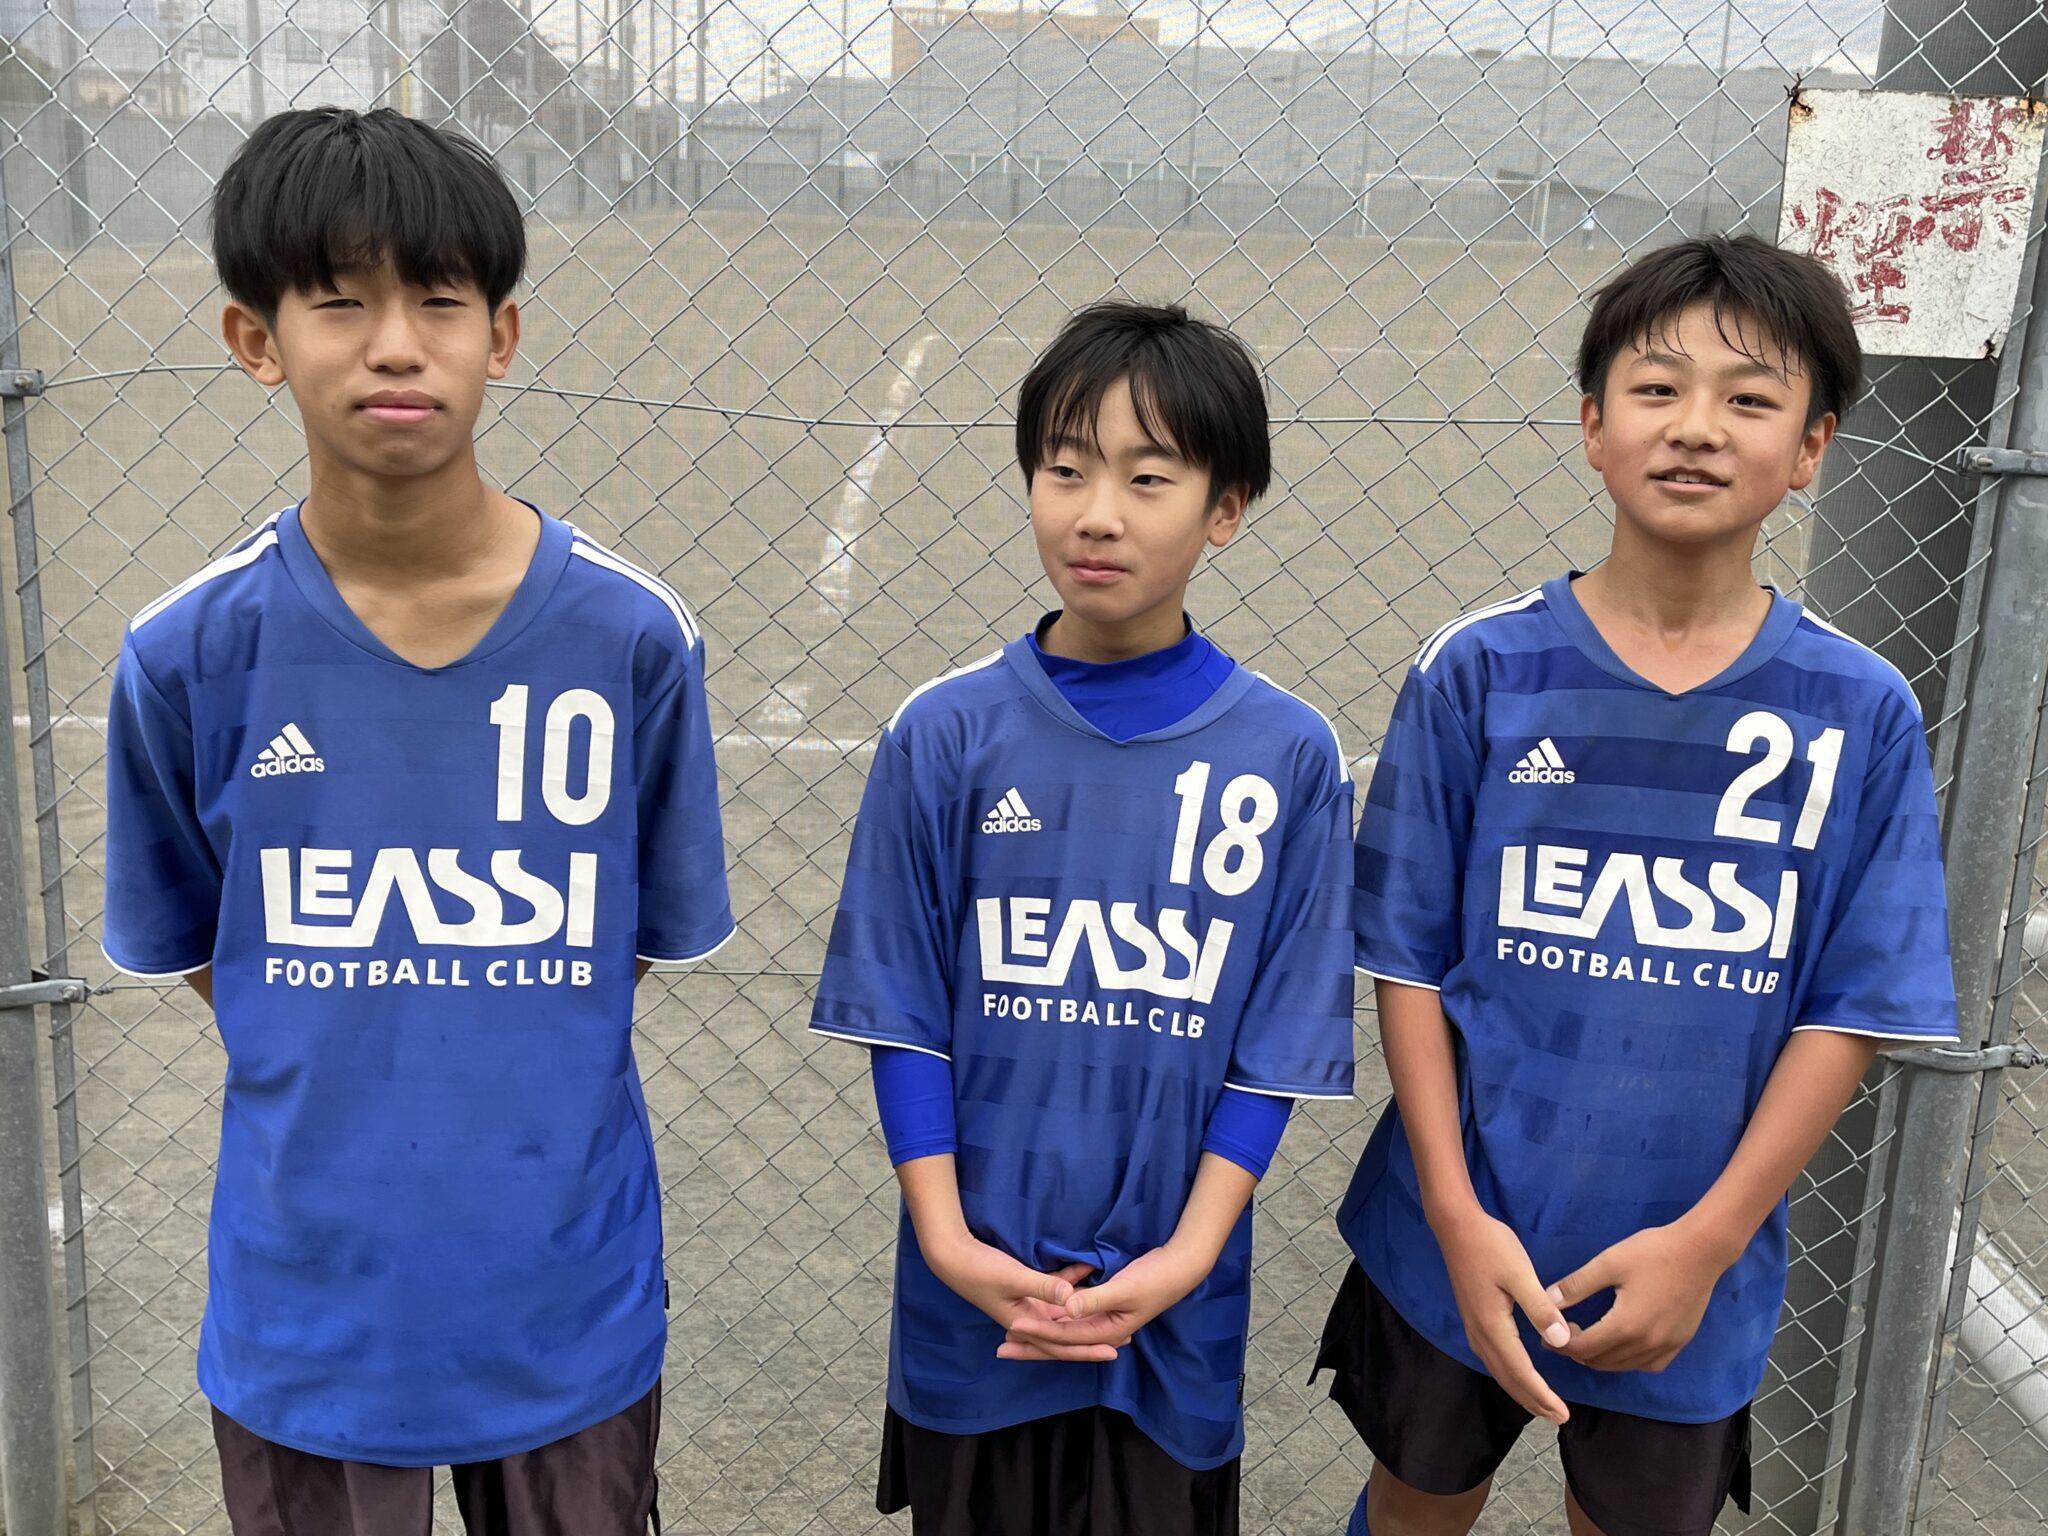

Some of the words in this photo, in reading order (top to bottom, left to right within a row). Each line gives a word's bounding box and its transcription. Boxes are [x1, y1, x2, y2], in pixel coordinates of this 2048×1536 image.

[250, 753, 326, 779] adidas
[489, 683, 615, 826] 10
[1508, 766, 1576, 784] adidas
[1713, 710, 1845, 851] 21
[981, 816, 1042, 834] adidas
[1169, 760, 1279, 896] 18
[260, 847, 598, 948] LEASSI
[1497, 844, 1798, 960] LEASSI
[265, 957, 470, 989] FOOTBALL
[485, 960, 594, 987] CLUB
[976, 896, 1234, 1005] LEASSI
[1497, 938, 1681, 987] FOOTBALL
[1692, 962, 1780, 995] CLUB
[983, 993, 1139, 1027] FOOTBALL
[1148, 1007, 1206, 1039] CLB
